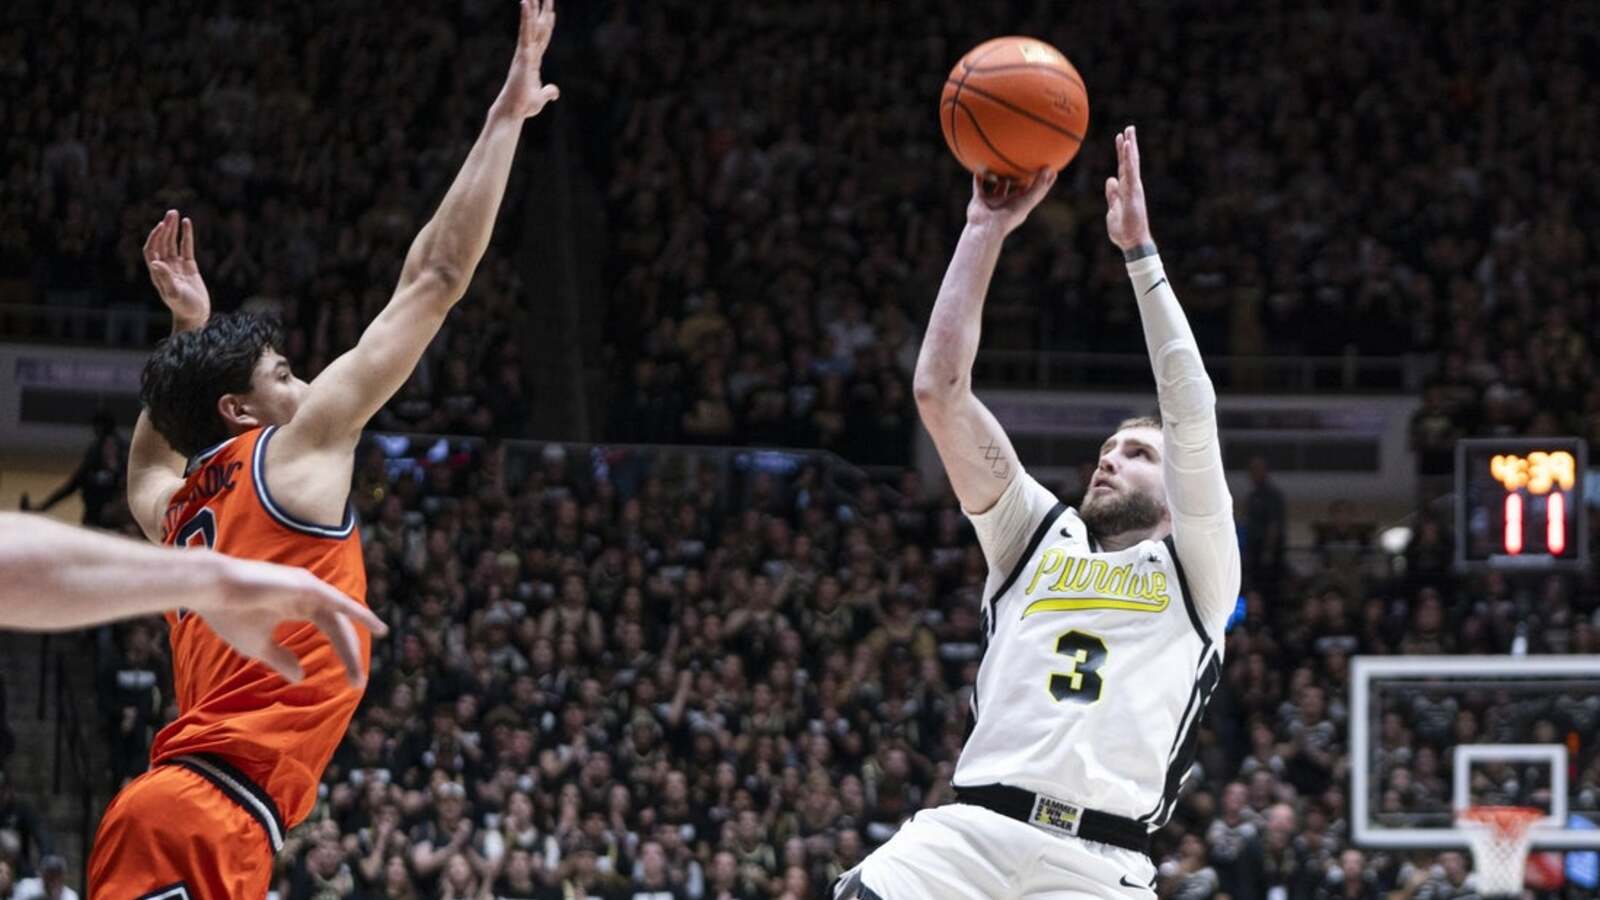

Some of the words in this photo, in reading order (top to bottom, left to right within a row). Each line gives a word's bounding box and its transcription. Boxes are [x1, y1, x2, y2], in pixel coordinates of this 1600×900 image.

[1505, 492, 1565, 555] 11
[1024, 548, 1169, 608] Purdue
[1047, 628, 1108, 704] 3
[1034, 812, 1073, 830] CNCER
[1036, 804, 1062, 817] DWN
[1039, 797, 1078, 814] HAMMER
